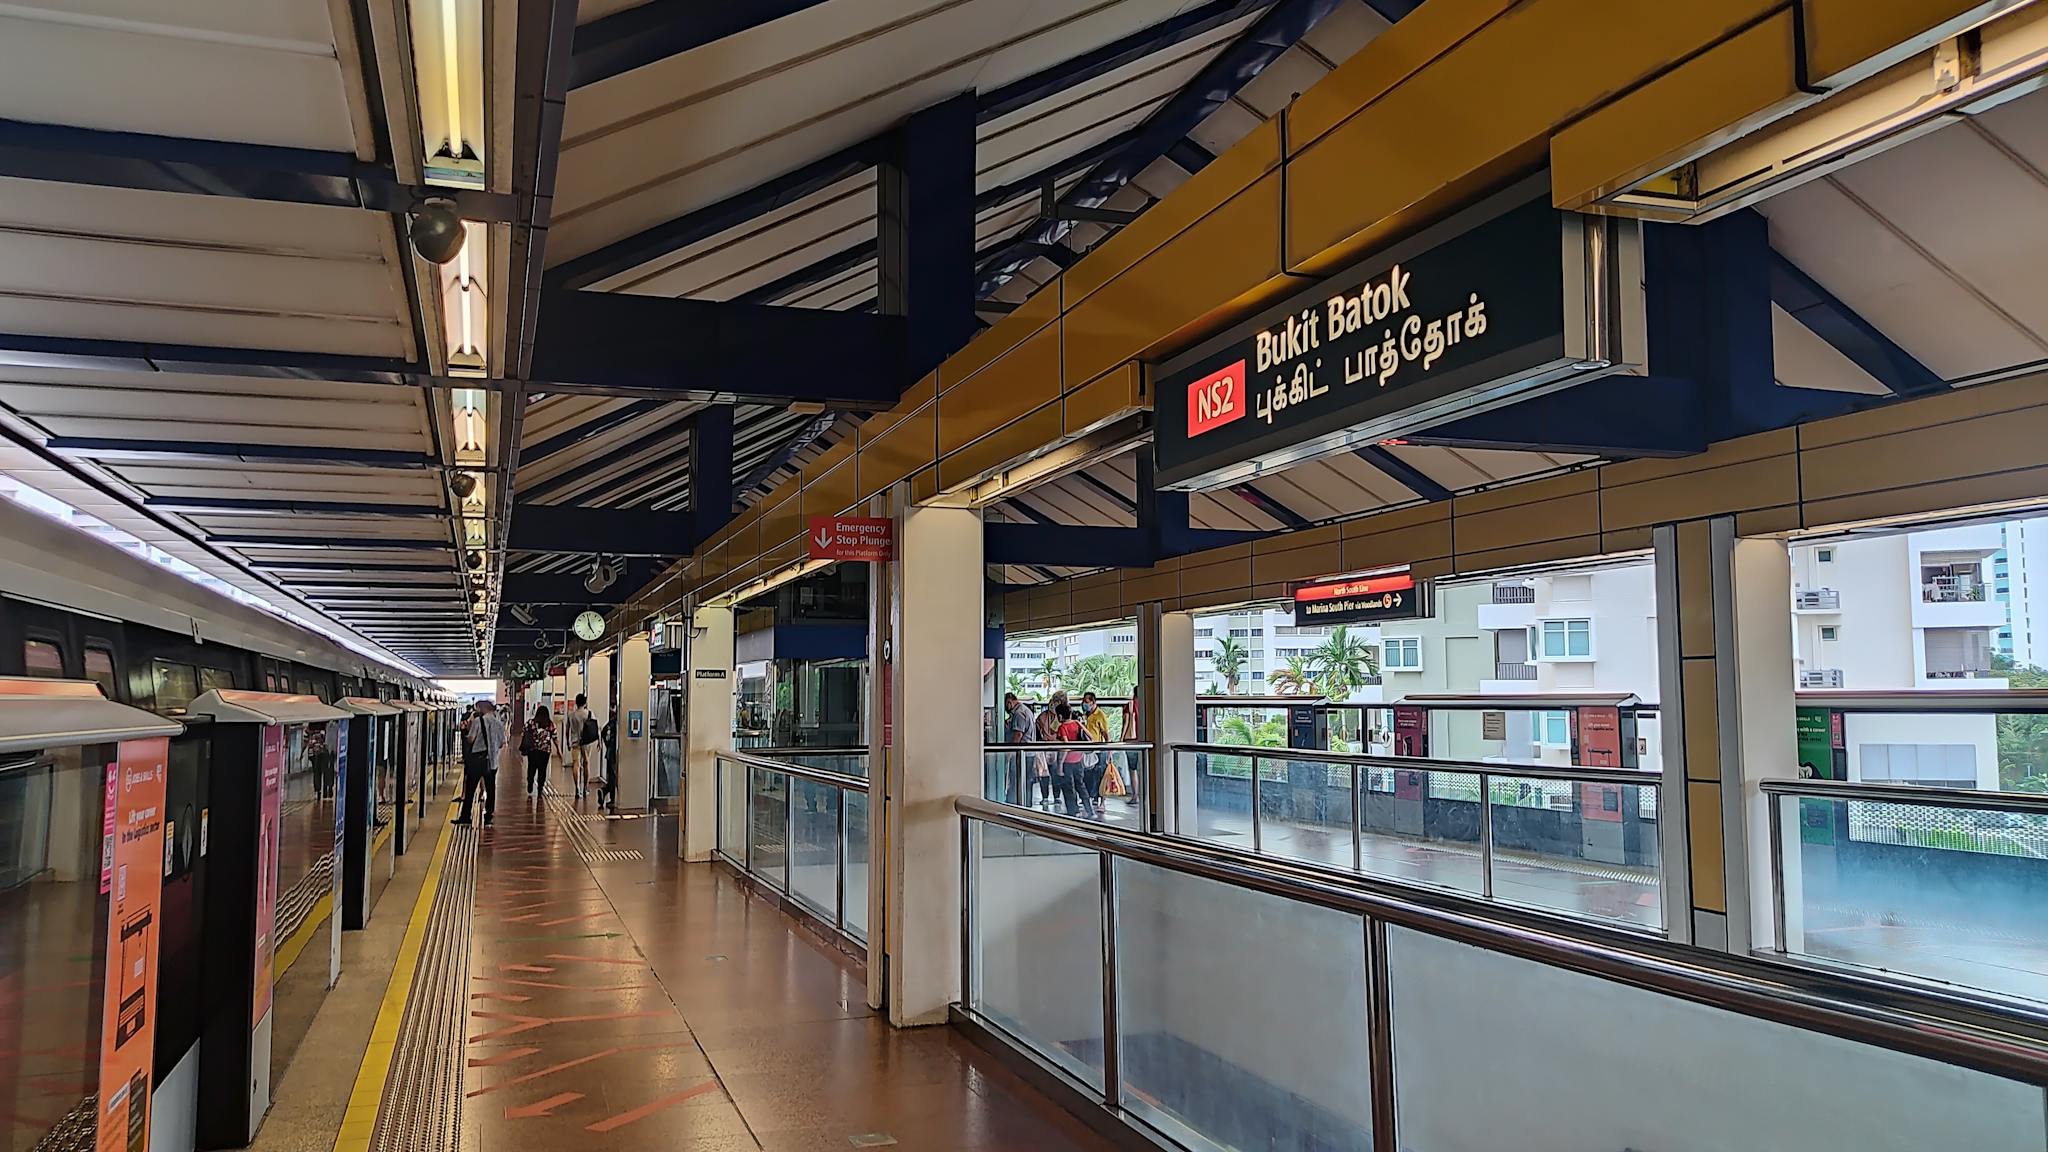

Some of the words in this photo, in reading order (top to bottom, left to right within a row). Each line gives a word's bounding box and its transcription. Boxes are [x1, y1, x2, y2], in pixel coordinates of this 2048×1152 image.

[1256, 309, 1319, 373] Bukit
[1327, 264, 1410, 342] Batok
[1256, 357, 1329, 424] புக்கிட்
[1344, 292, 1487, 387] பாத்தோக்
[1197, 376, 1235, 423] NS2
[836, 522, 886, 535] Emergency
[836, 535, 858, 547] Stop
[855, 549, 878, 557] Platform
[1333, 586, 1345, 596] North
[1346, 585, 1359, 594] South
[1359, 583, 1369, 592] Line
[1305, 605, 1312, 615] to
[1312, 602, 1328, 614] Marina
[1328, 600, 1344, 612] South
[1344, 600, 1354, 611] Pier
